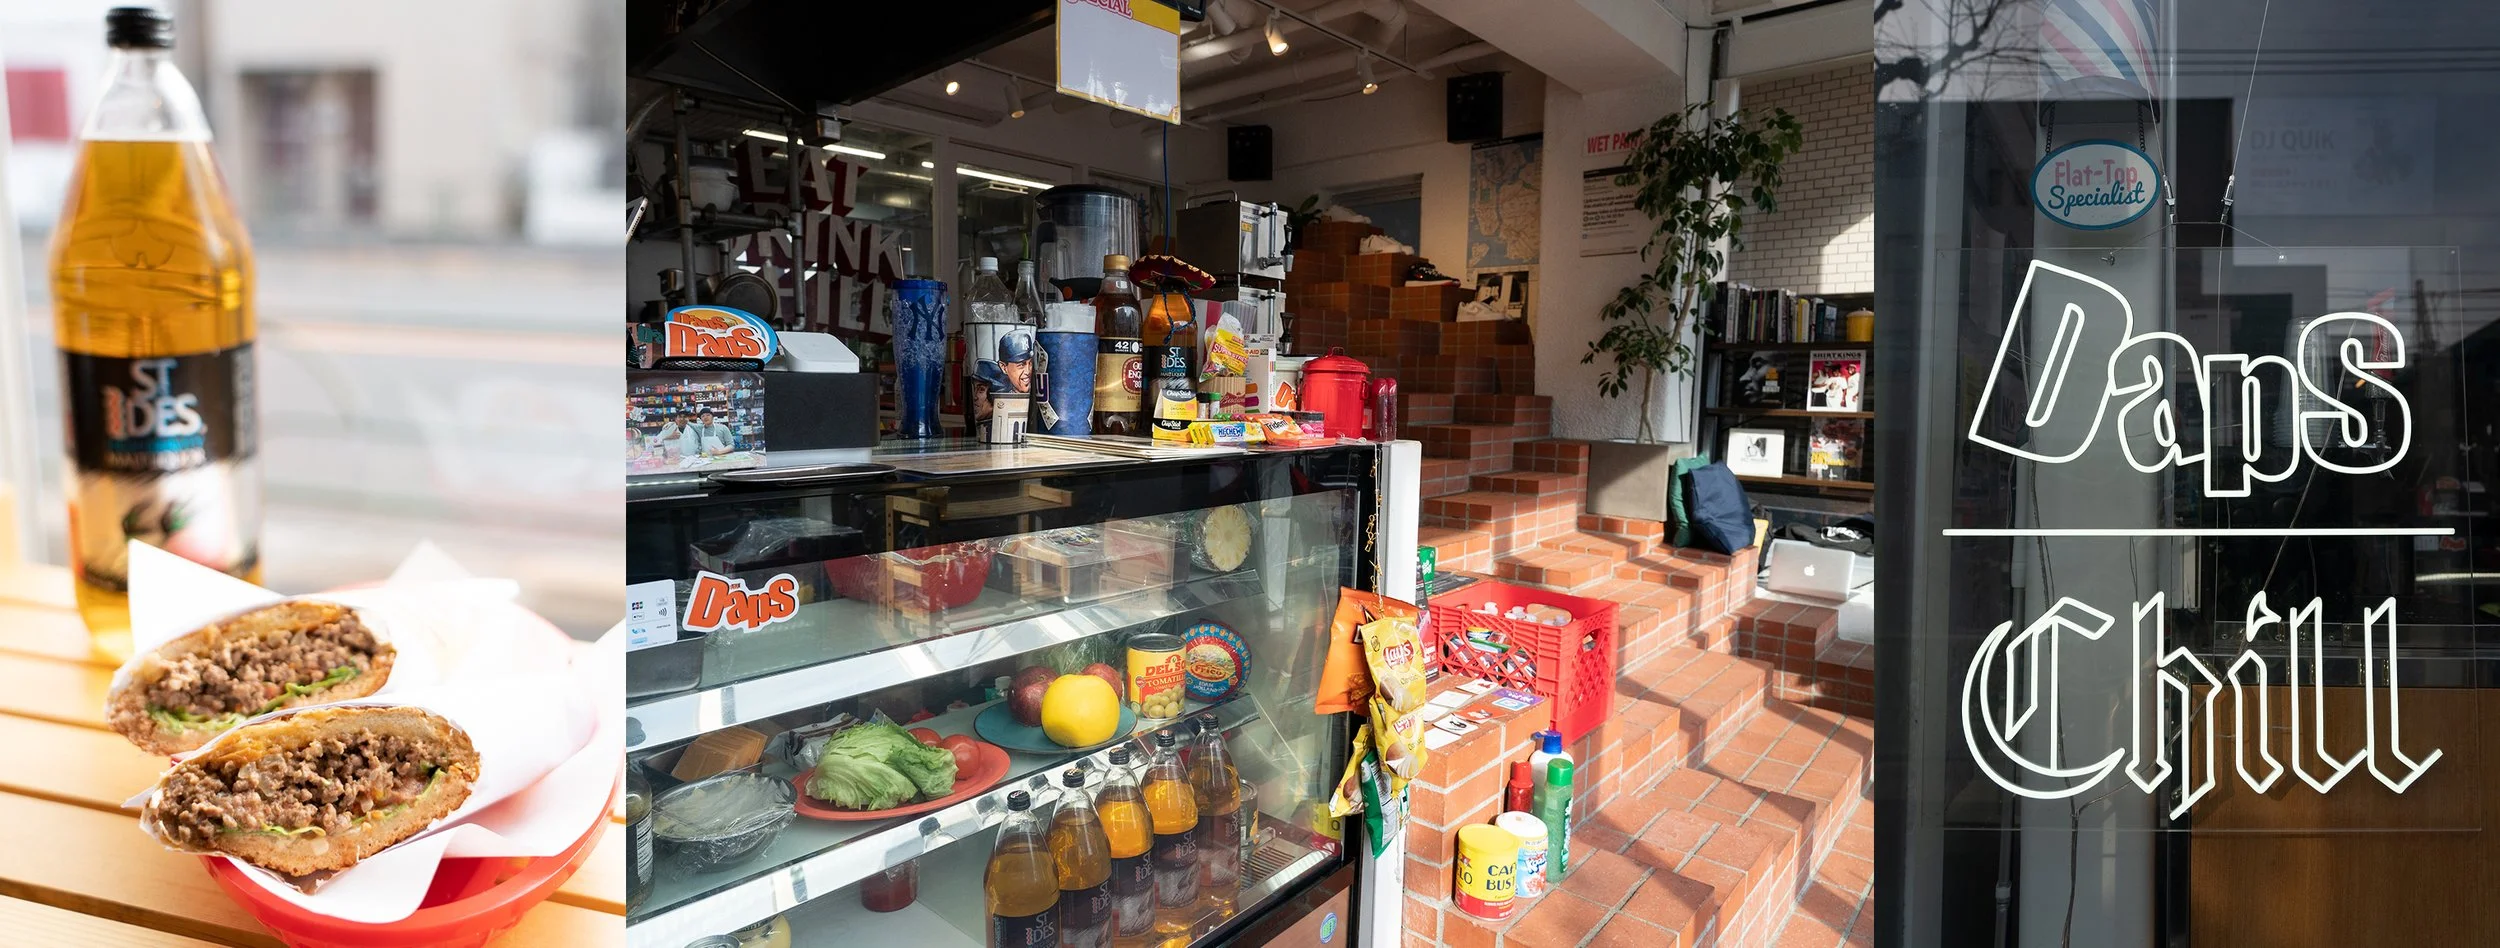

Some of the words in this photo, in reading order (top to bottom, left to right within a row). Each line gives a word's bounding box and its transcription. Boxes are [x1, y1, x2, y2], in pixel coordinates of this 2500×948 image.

[1587, 135, 1610, 153] WET
[2251, 130, 2276, 150] DJ
[2281, 129, 2336, 152] QUIK
[738, 138, 868, 216] EAT
[2055, 160, 2138, 191] Flat-Top
[2048, 180, 2146, 217] Specialist
[669, 322, 761, 358] Daps
[1115, 341, 1129, 349] 42
[1169, 346, 1181, 358] ST
[131, 357, 178, 399] ST
[1968, 260, 2412, 497] Daps
[104, 386, 206, 441] IDES
[1266, 419, 1288, 432] Trident
[687, 576, 796, 629] Daps
[1385, 643, 1411, 665] Lay's
[1145, 665, 1171, 676] DEL
[1962, 591, 2444, 820] Chill
[1036, 911, 1049, 928] ST
